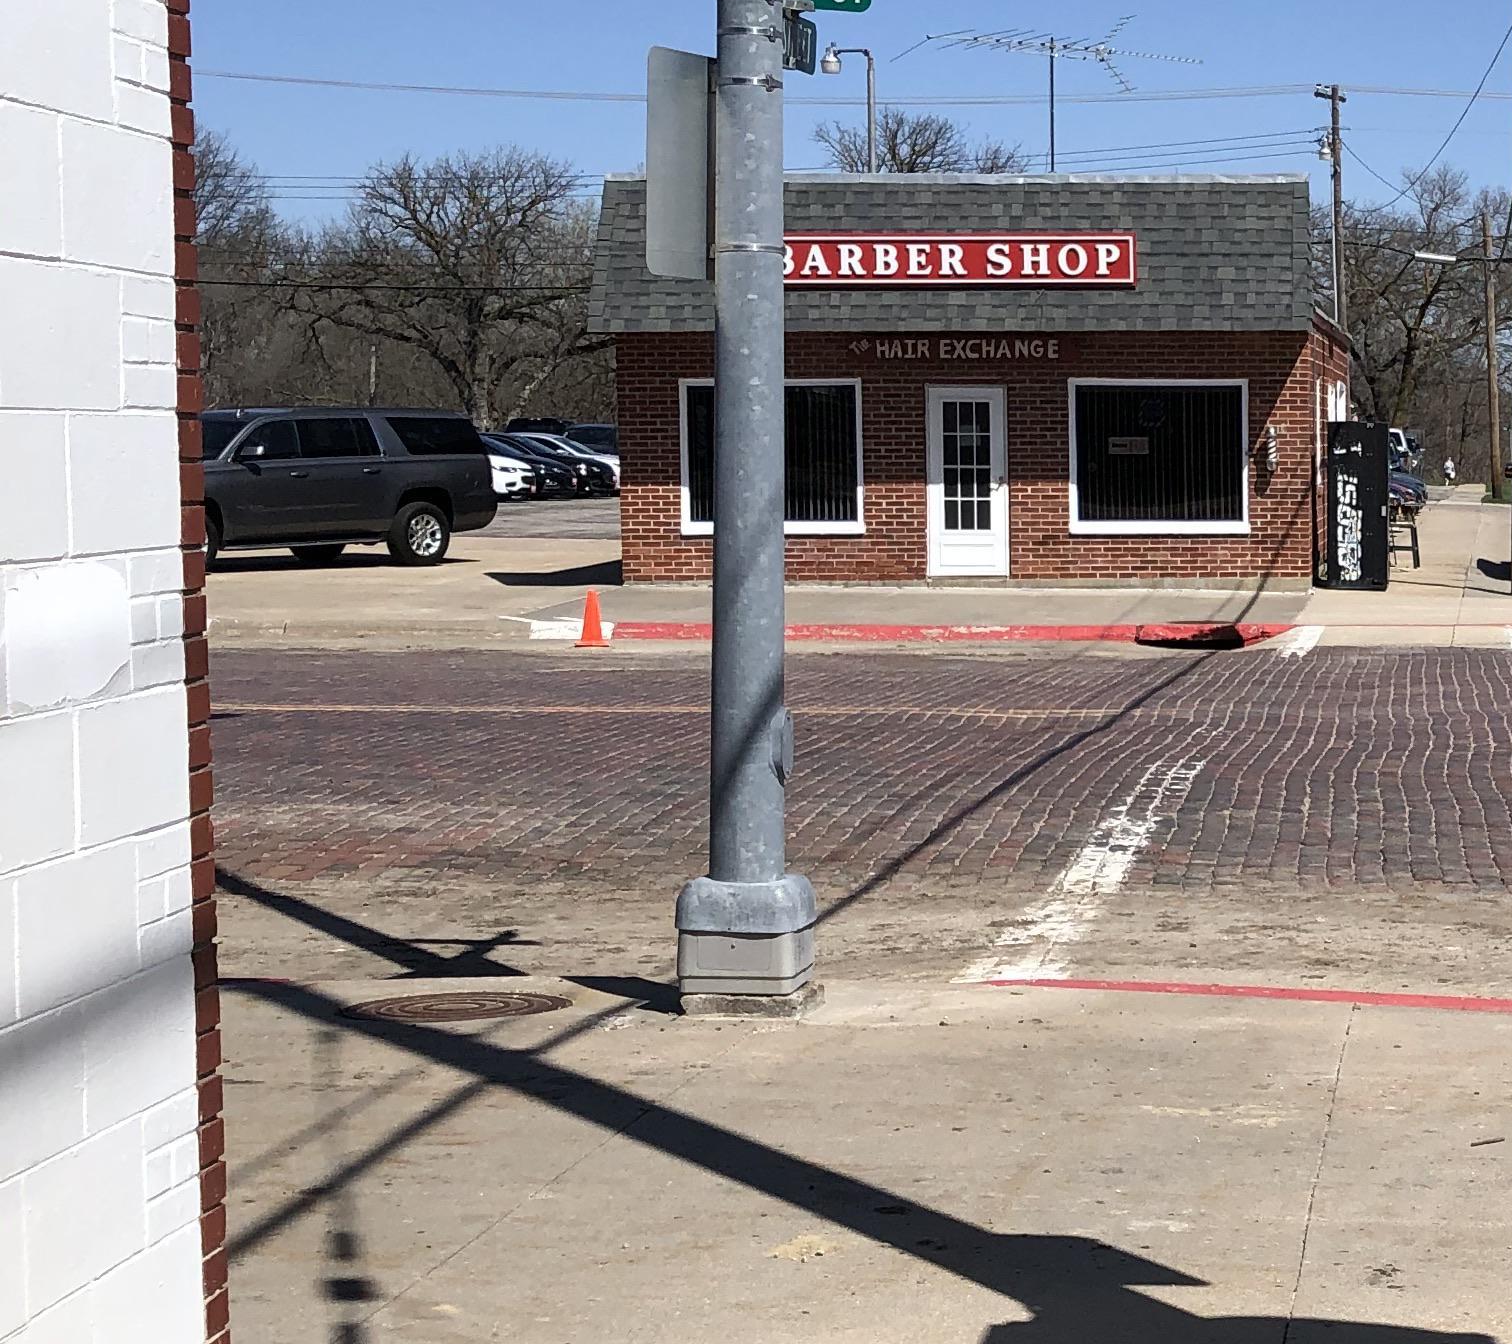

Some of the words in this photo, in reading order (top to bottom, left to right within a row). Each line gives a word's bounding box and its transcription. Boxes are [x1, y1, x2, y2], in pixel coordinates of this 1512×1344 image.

[986, 243, 1121, 276] SHOP
[876, 339, 930, 359] HAIR
[939, 339, 1059, 359] EXCHANGE
